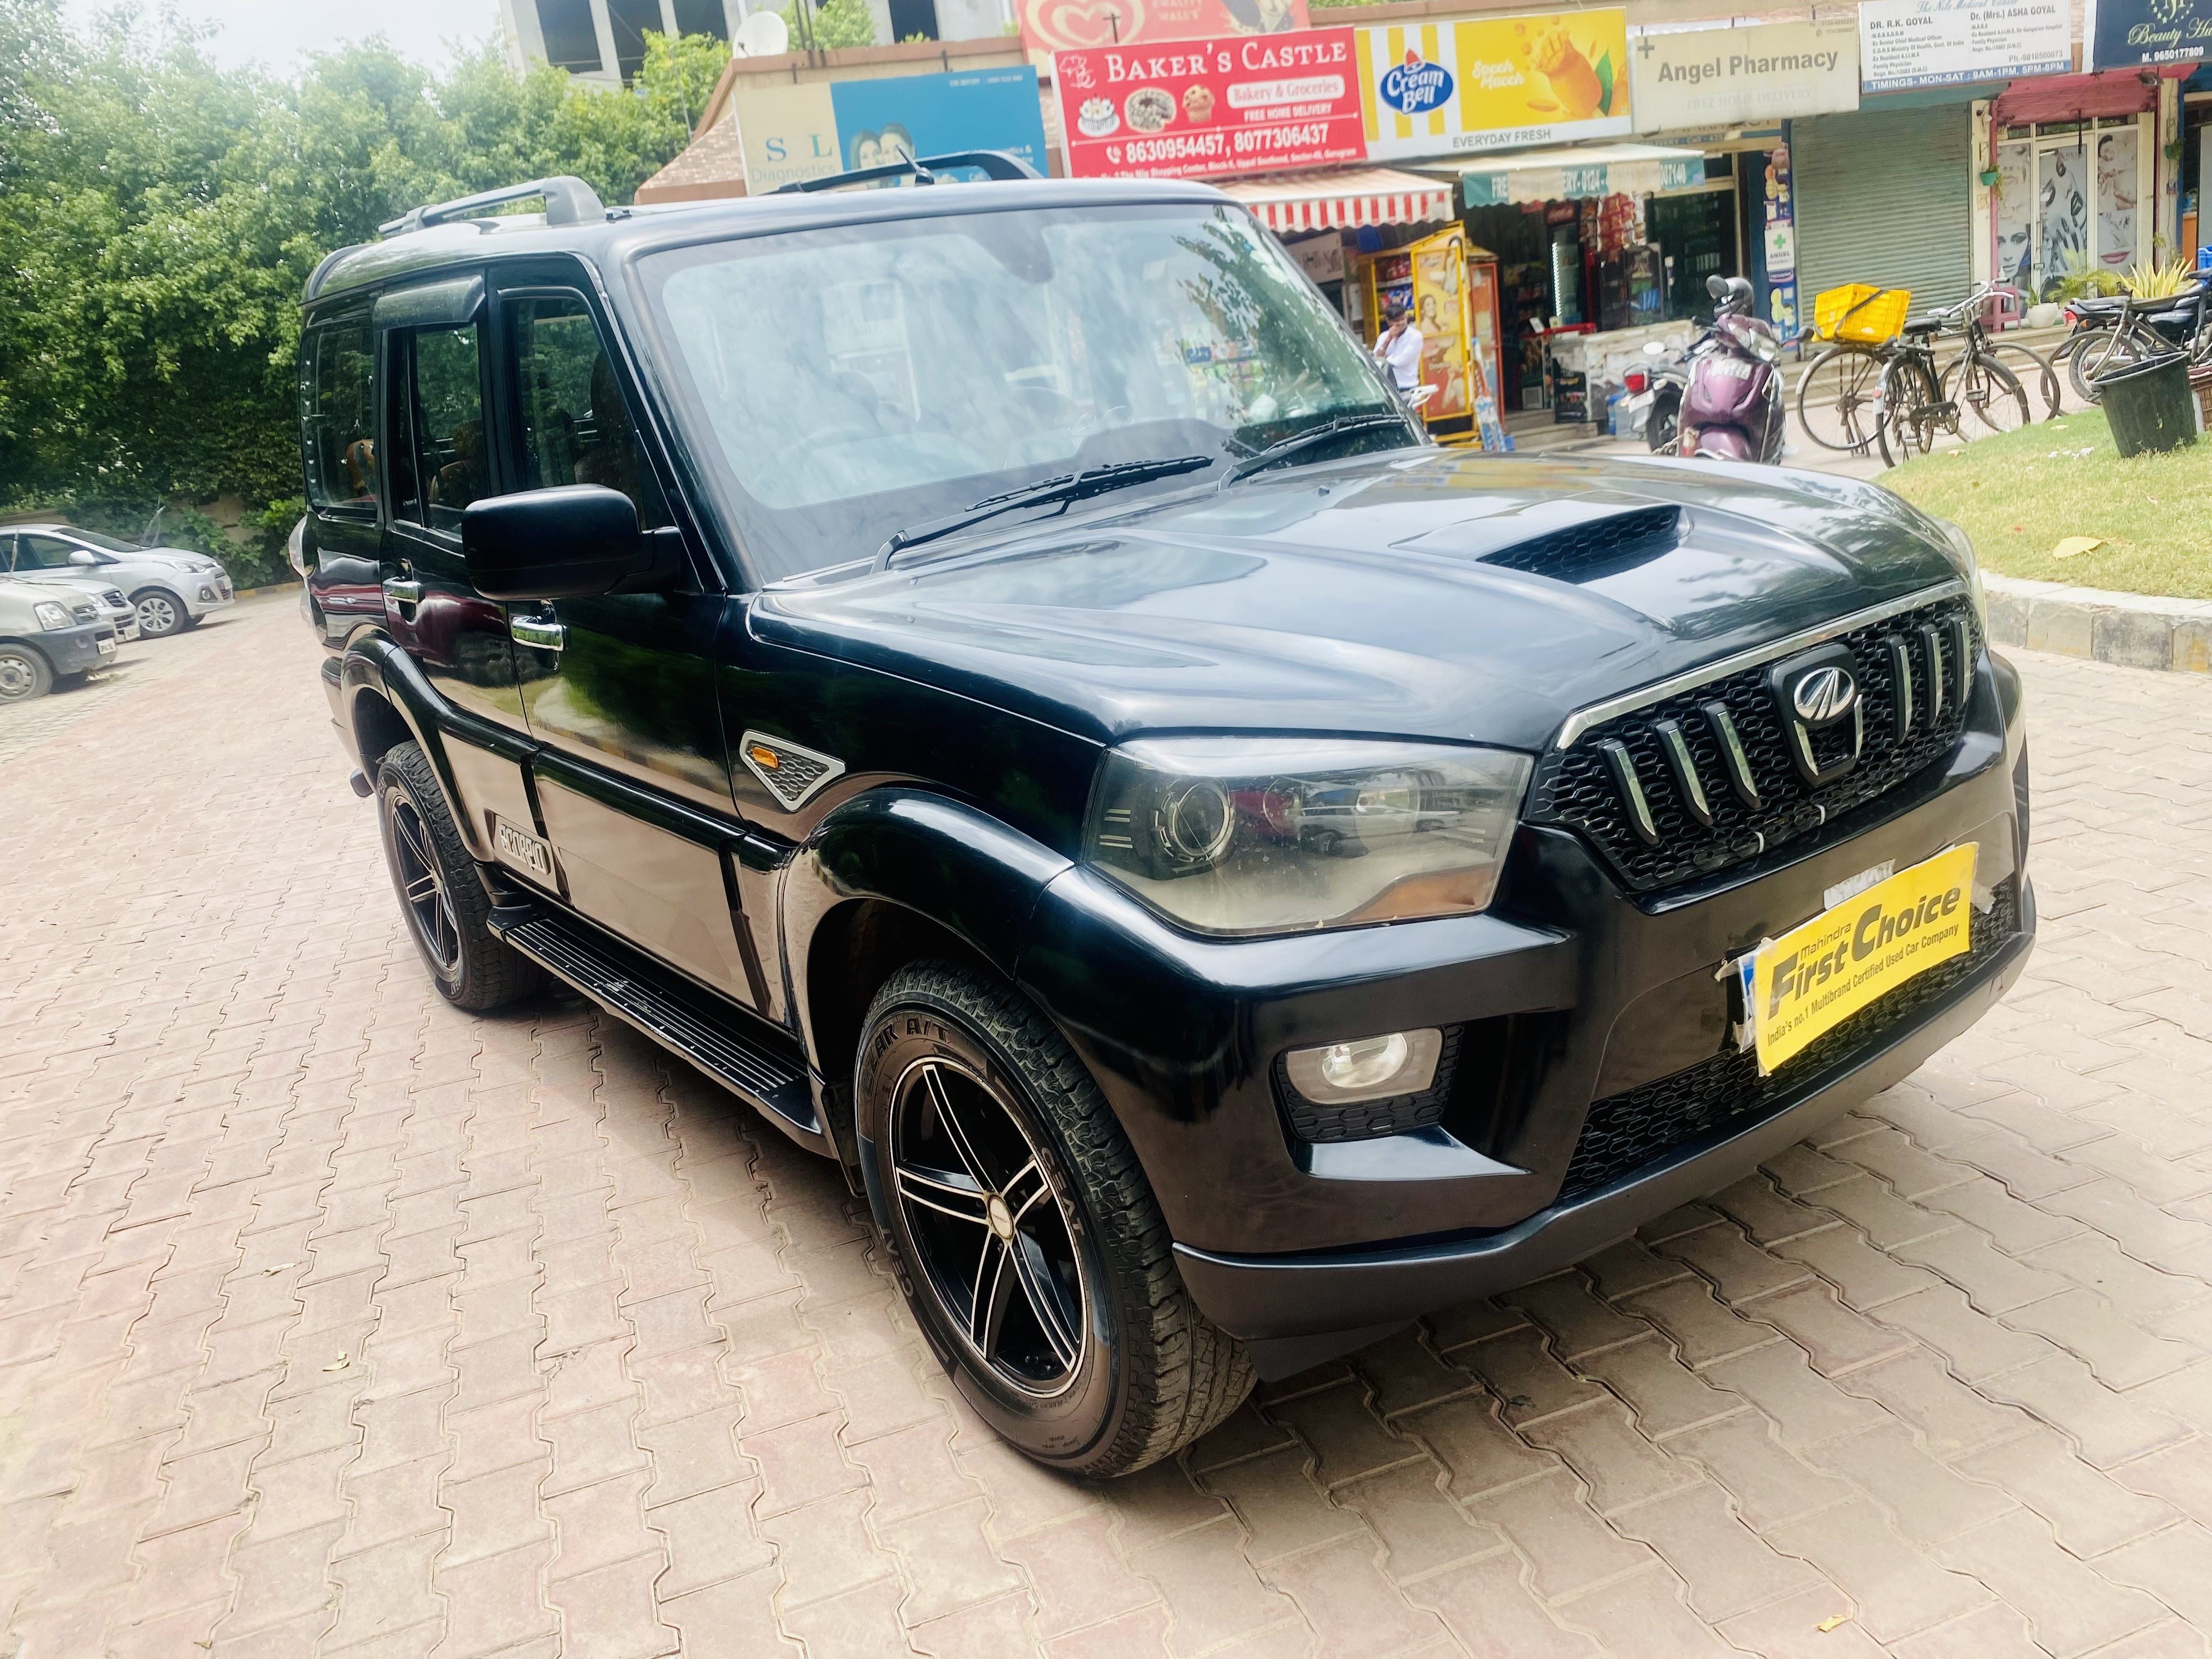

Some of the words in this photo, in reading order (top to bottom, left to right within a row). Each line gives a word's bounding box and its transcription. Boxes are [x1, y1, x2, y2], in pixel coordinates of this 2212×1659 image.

[1870, 21, 1884, 30] DR.
[1887, 19, 1903, 27] R.K.
[1906, 16, 1933, 26] GOYAL
[1970, 12, 1980, 21] Dr.
[1983, 9, 2005, 21] (Mrs.)
[2007, 8, 2028, 18] ASHA
[2031, 5, 2056, 15] GOYAL
[2128, 22, 2183, 48] Beauty
[1105, 42, 1232, 83] BAKER'S
[1241, 42, 1348, 69] CASTLE
[1658, 57, 1721, 84] Angel
[1729, 50, 1838, 76] Pharmacy
[2142, 52, 2152, 63] M.
[1233, 86, 1272, 101] Bakery
[1276, 83, 1283, 98] &
[1286, 80, 1339, 97] Groceries
[1386, 68, 1444, 97] Cream
[1920, 72, 1964, 84] MON-SAT
[1292, 102, 1332, 117] DELIVERY
[1402, 85, 1436, 113] Bell
[1756, 88, 1812, 105] DELIVERY
[766, 136, 787, 162] S
[810, 133, 833, 159] L
[1234, 123, 1329, 153] 8077306437
[1453, 131, 1513, 149] EVERYDAY
[1515, 128, 1551, 143] FRESH
[752, 164, 836, 184] Diagnostics
[1769, 250, 1791, 259] ANGEL
[1767, 940, 1849, 1020] First
[1851, 887, 1961, 962] Choice
[1800, 923, 1852, 961] mahindra
[1767, 1019, 1793, 1047] India's
[1811, 978, 1852, 1016] Multibrand
[1853, 960, 1884, 988] Certified
[1886, 946, 1904, 968] Used
[1906, 941, 1919, 958] Car
[1921, 923, 1959, 952] Company
[906, 1017, 951, 1043] A/T
[1042, 1147, 1085, 1236] CEAT
